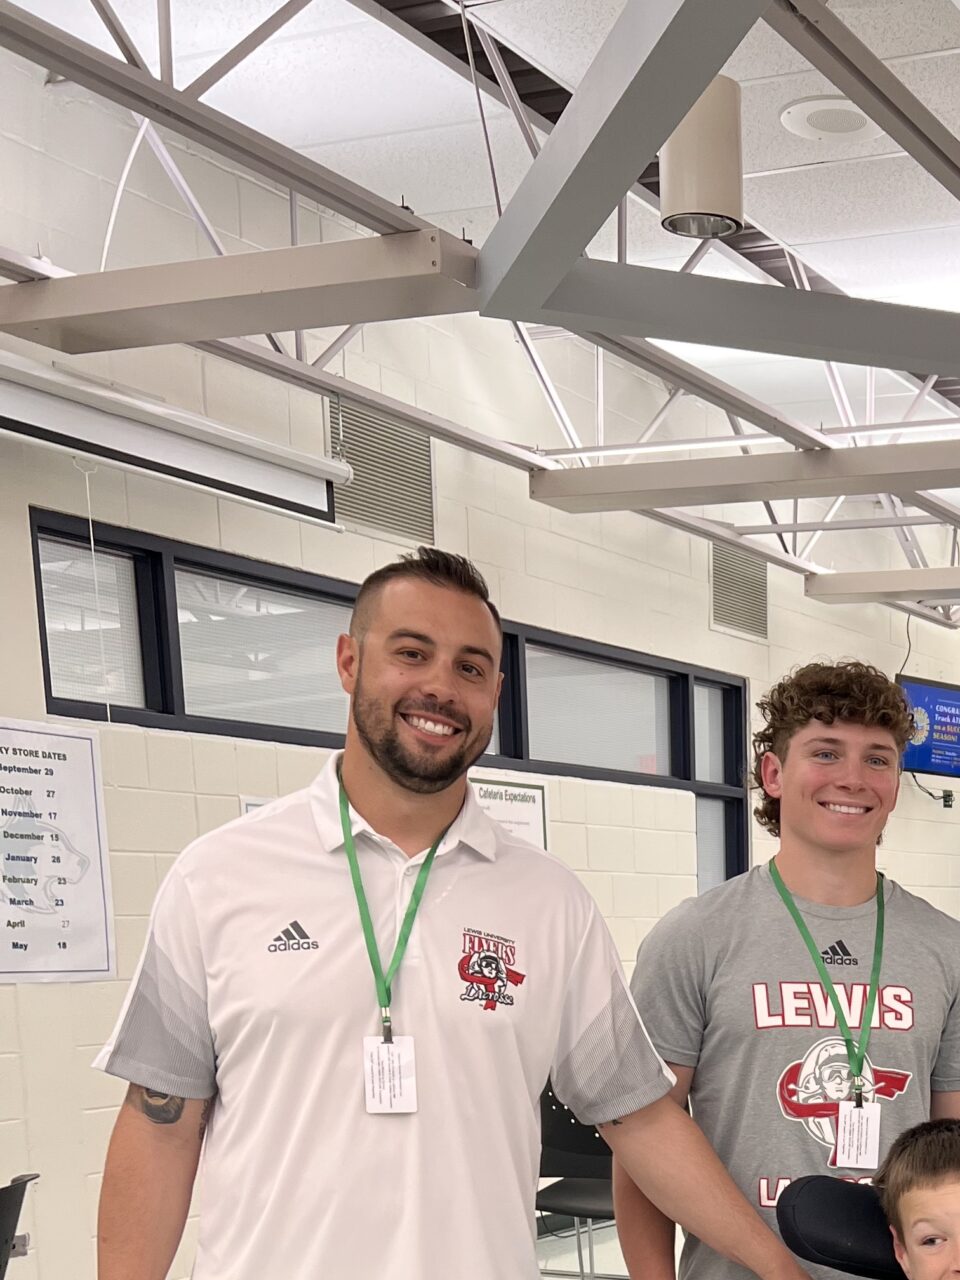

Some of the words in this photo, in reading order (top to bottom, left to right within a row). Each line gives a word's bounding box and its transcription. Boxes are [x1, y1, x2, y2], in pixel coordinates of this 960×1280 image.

[12, 748, 40, 758] STORE
[42, 751, 67, 761] DATES
[44, 767, 54, 776] 29
[0, 786, 32, 796] October
[46, 789, 56, 798] 27
[479, 787, 503, 801] Cafeteria
[504, 789, 536, 804] Expectations
[1, 808, 43, 819] November
[48, 811, 57, 820] 17
[3, 831, 44, 841] December
[50, 834, 59, 842] 15
[5, 853, 38, 864] January
[2, 875, 38, 886] February
[57, 877, 67, 885] 23
[9, 897, 34, 906] March
[55, 898, 64, 906] 23
[6, 919, 25, 929] April
[61, 920, 70, 928] 27
[463, 927, 482, 936] LEWIS
[483, 931, 516, 945] UNIVERSITY
[12, 942, 28, 951] May
[58, 941, 67, 950] 18
[267, 938, 320, 953] adidas
[462, 932, 516, 966] FLYERS
